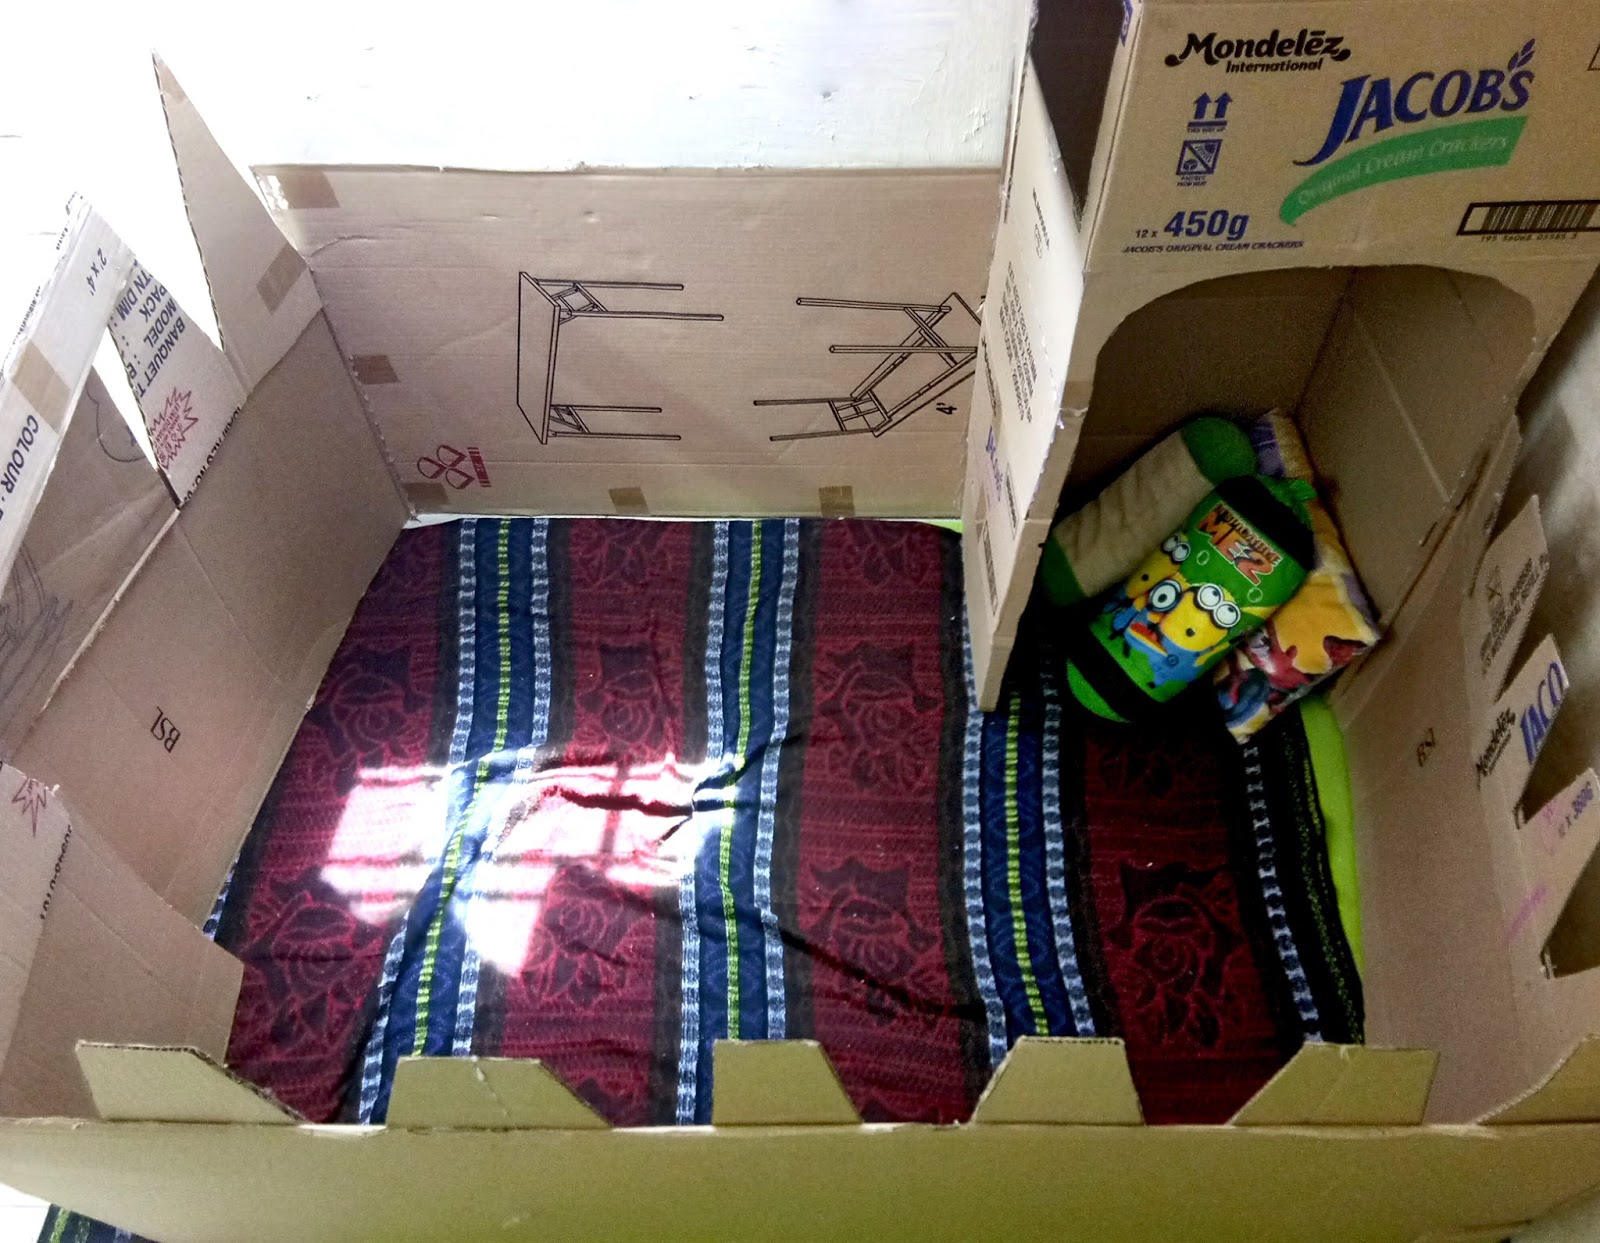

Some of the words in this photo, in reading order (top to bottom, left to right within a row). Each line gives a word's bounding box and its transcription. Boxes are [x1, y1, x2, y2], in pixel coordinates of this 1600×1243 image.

[1225, 57, 1323, 74] International
[1135, 230, 1147, 238] 12
[1164, 209, 1249, 241] 450g
[133, 269, 153, 295] TN
[115, 287, 138, 321] DIM
[138, 284, 168, 323] PACK
[143, 298, 177, 348] MODEL
[144, 316, 186, 387] BANQUET
[0, 414, 39, 494] COLOUR
